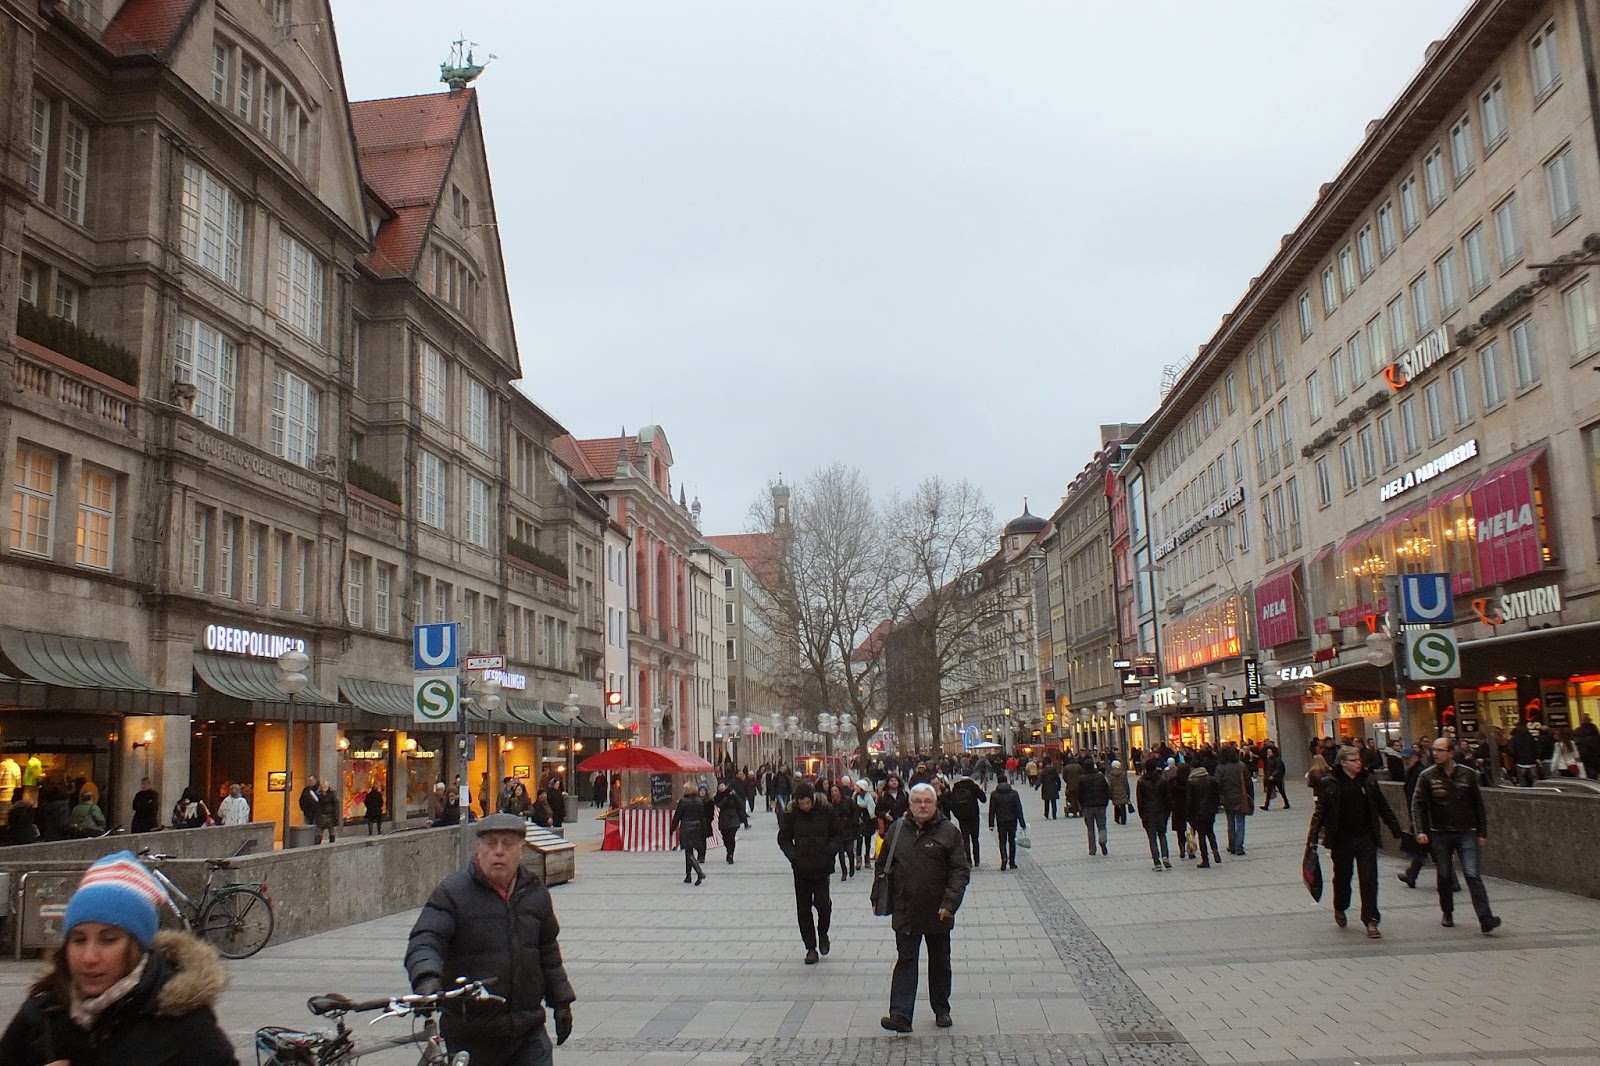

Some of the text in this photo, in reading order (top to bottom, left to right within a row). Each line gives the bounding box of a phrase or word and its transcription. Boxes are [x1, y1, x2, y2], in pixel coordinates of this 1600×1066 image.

[1404, 325, 1449, 382] SATURN
[1381, 439, 1477, 501] HELA PARFUMERIE
[1478, 504, 1533, 543] HELA
[1263, 599, 1286, 620] HELA
[1408, 577, 1446, 619] U
[1500, 584, 1561, 621] SATURN
[419, 626, 450, 666] U
[1418, 636, 1449, 672] S
[1276, 665, 1313, 681] ELA
[422, 681, 449, 716] S
